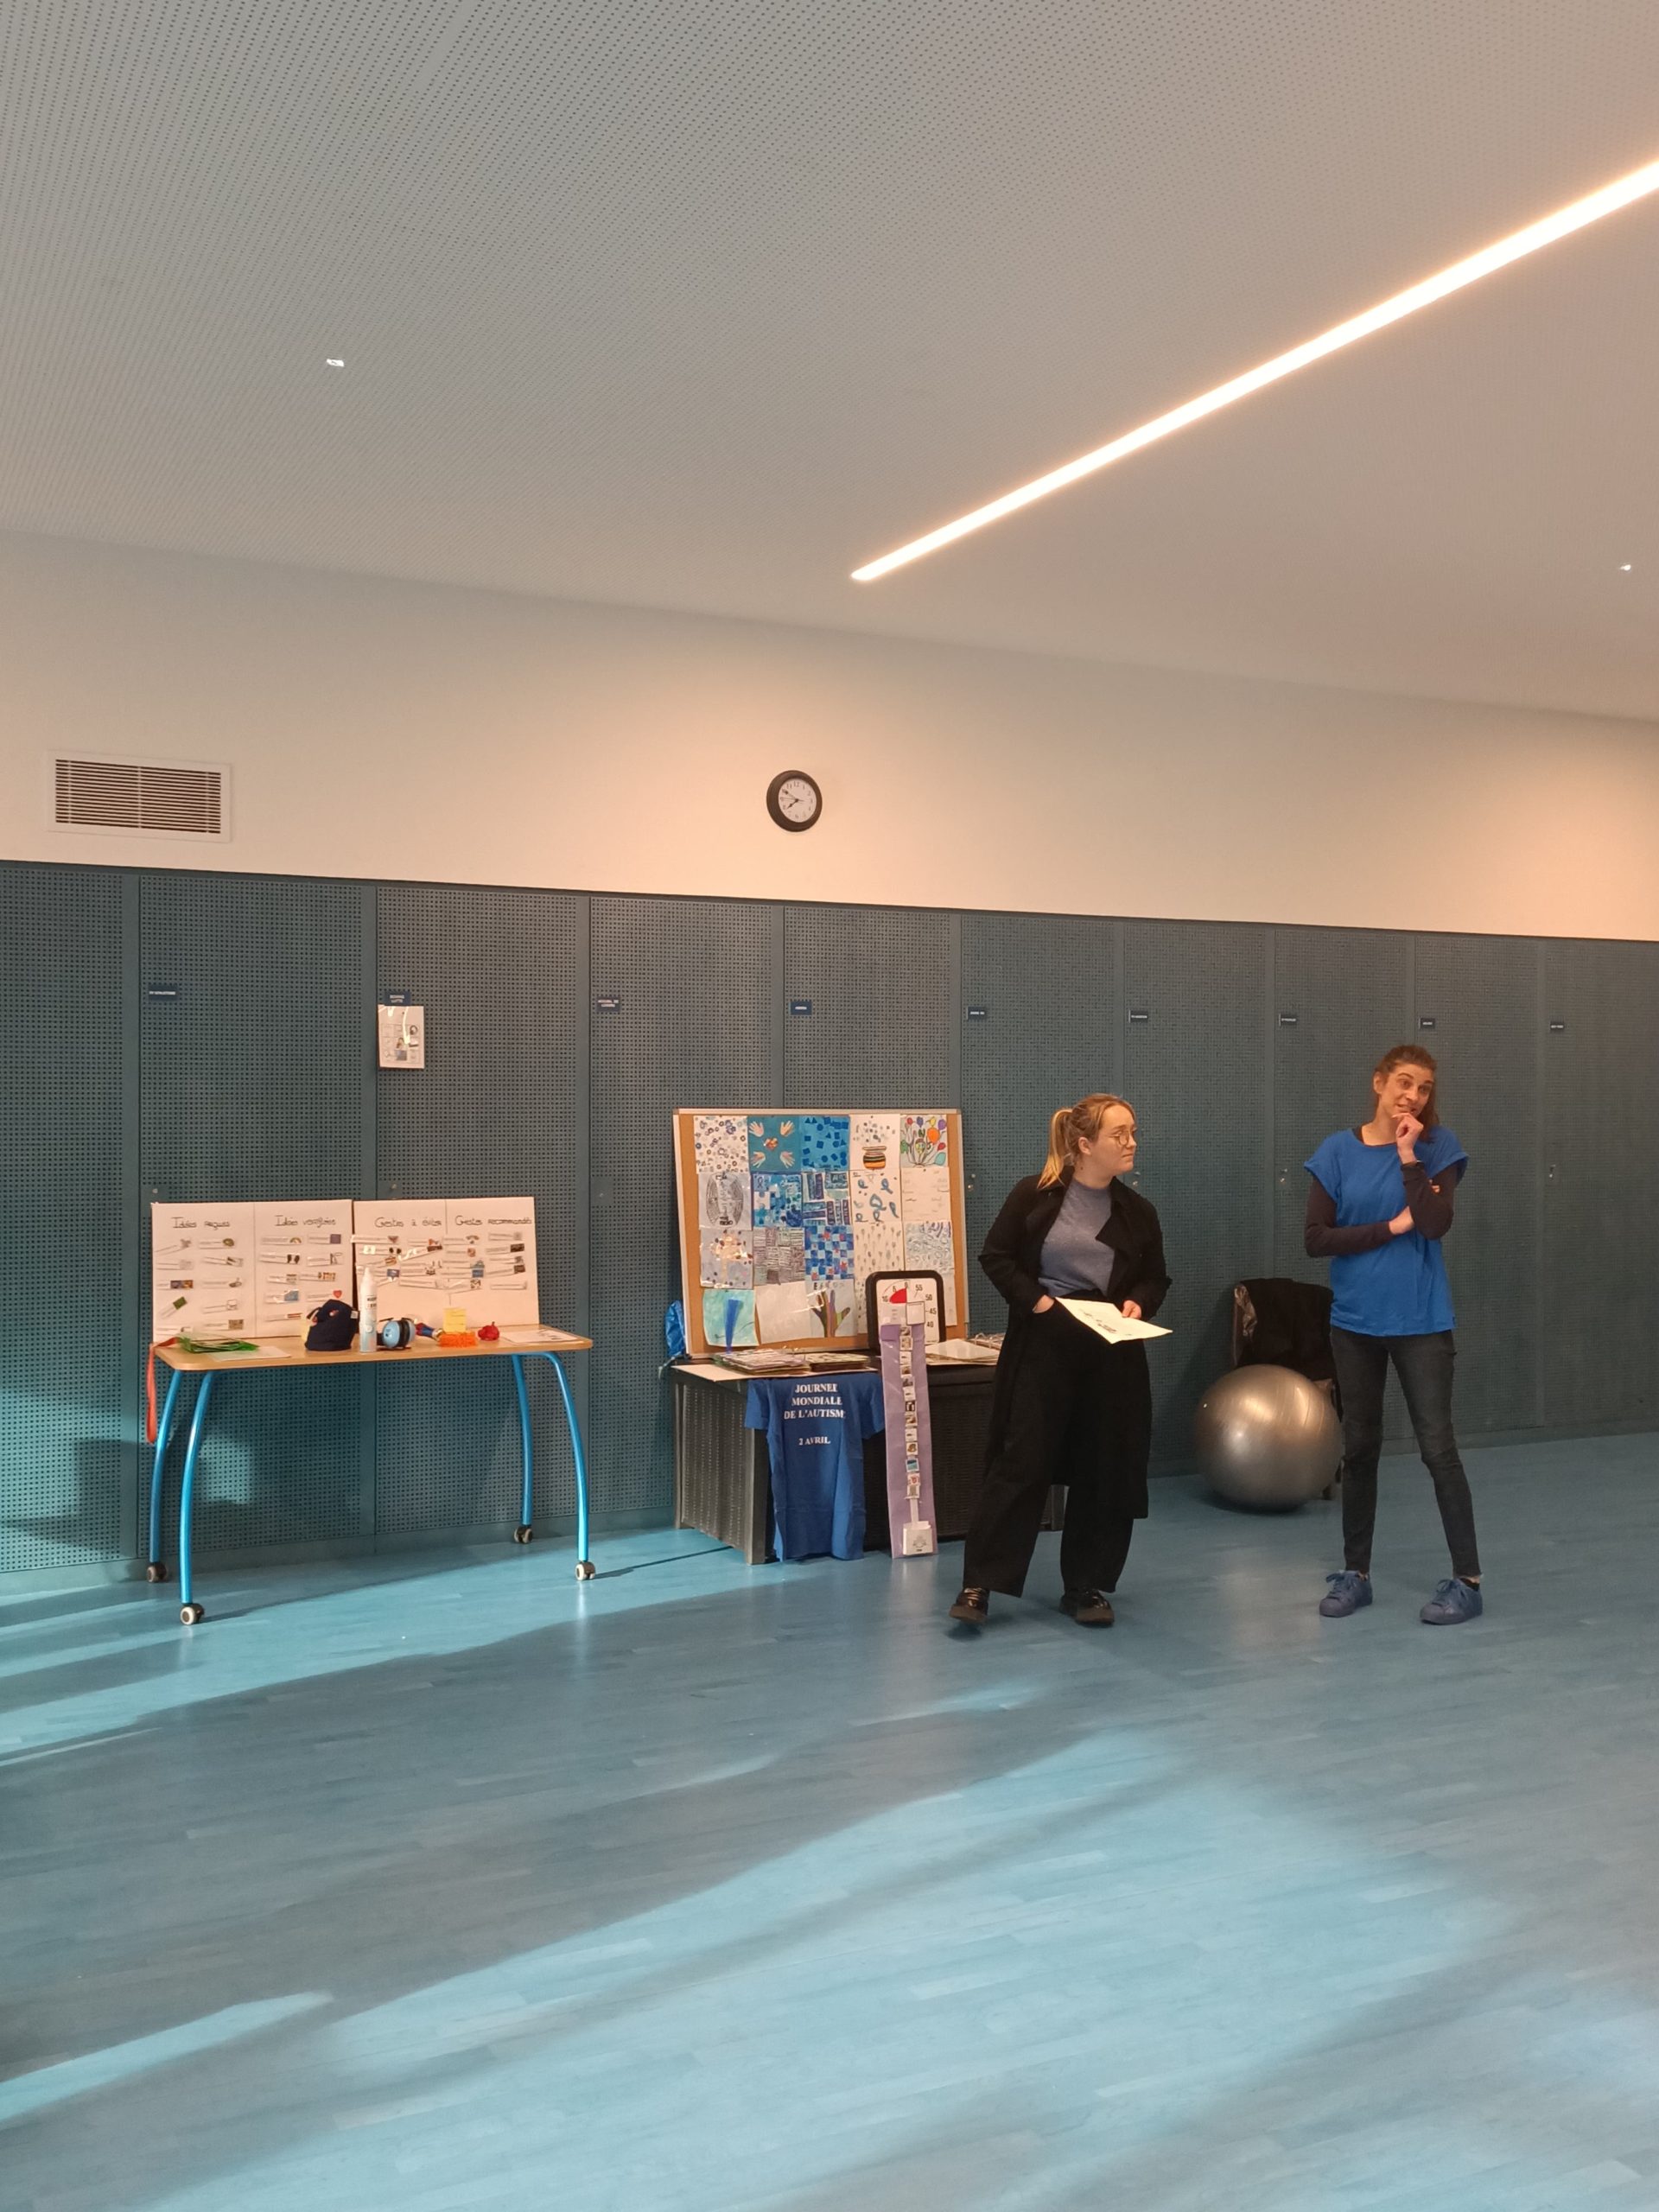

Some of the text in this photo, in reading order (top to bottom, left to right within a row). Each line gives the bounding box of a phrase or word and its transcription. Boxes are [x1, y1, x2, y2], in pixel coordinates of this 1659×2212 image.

[791, 1396, 842, 1406] MONDIALE
[784, 1410, 796, 1420] DE
[804, 1436, 831, 1445] AVRIL
